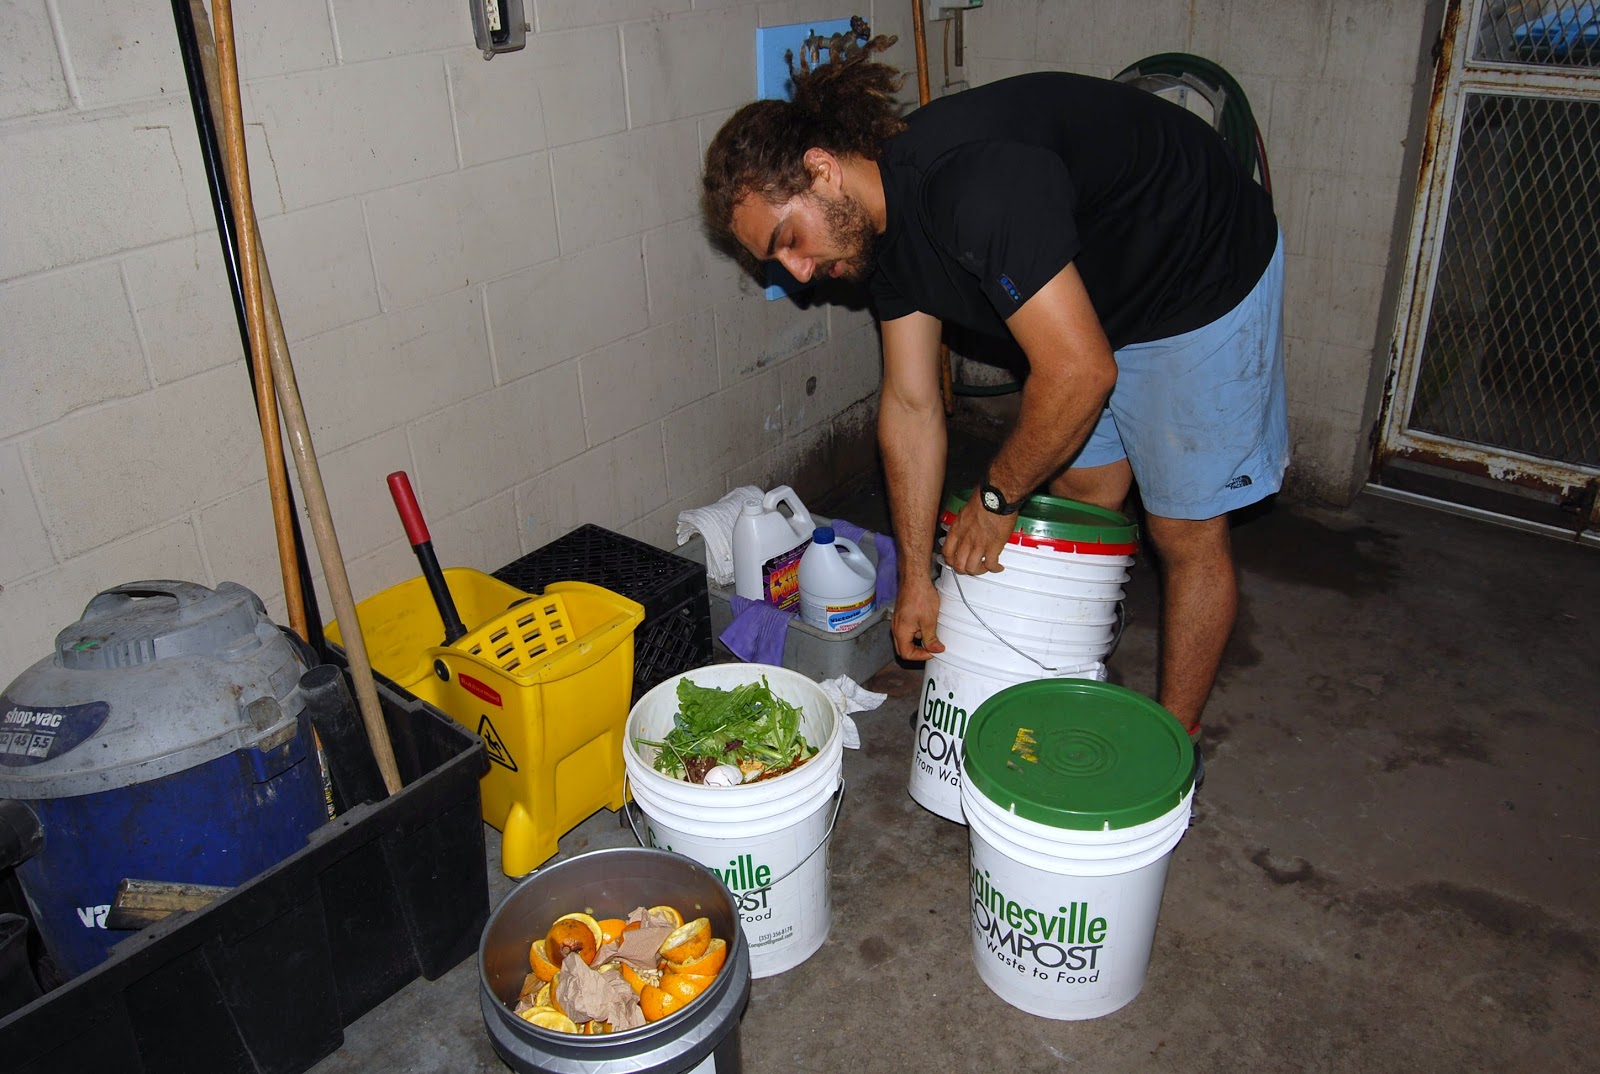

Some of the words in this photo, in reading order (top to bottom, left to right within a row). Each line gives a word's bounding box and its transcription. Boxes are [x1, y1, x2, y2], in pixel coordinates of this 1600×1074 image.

[830, 611, 861, 622] Victoria
[32, 736, 50, 748] 5.5
[915, 751, 934, 776] From
[706, 854, 771, 891] ville
[986, 936, 1026, 974] Waste
[1033, 967, 1049, 980] to
[1057, 969, 1100, 984] Food
